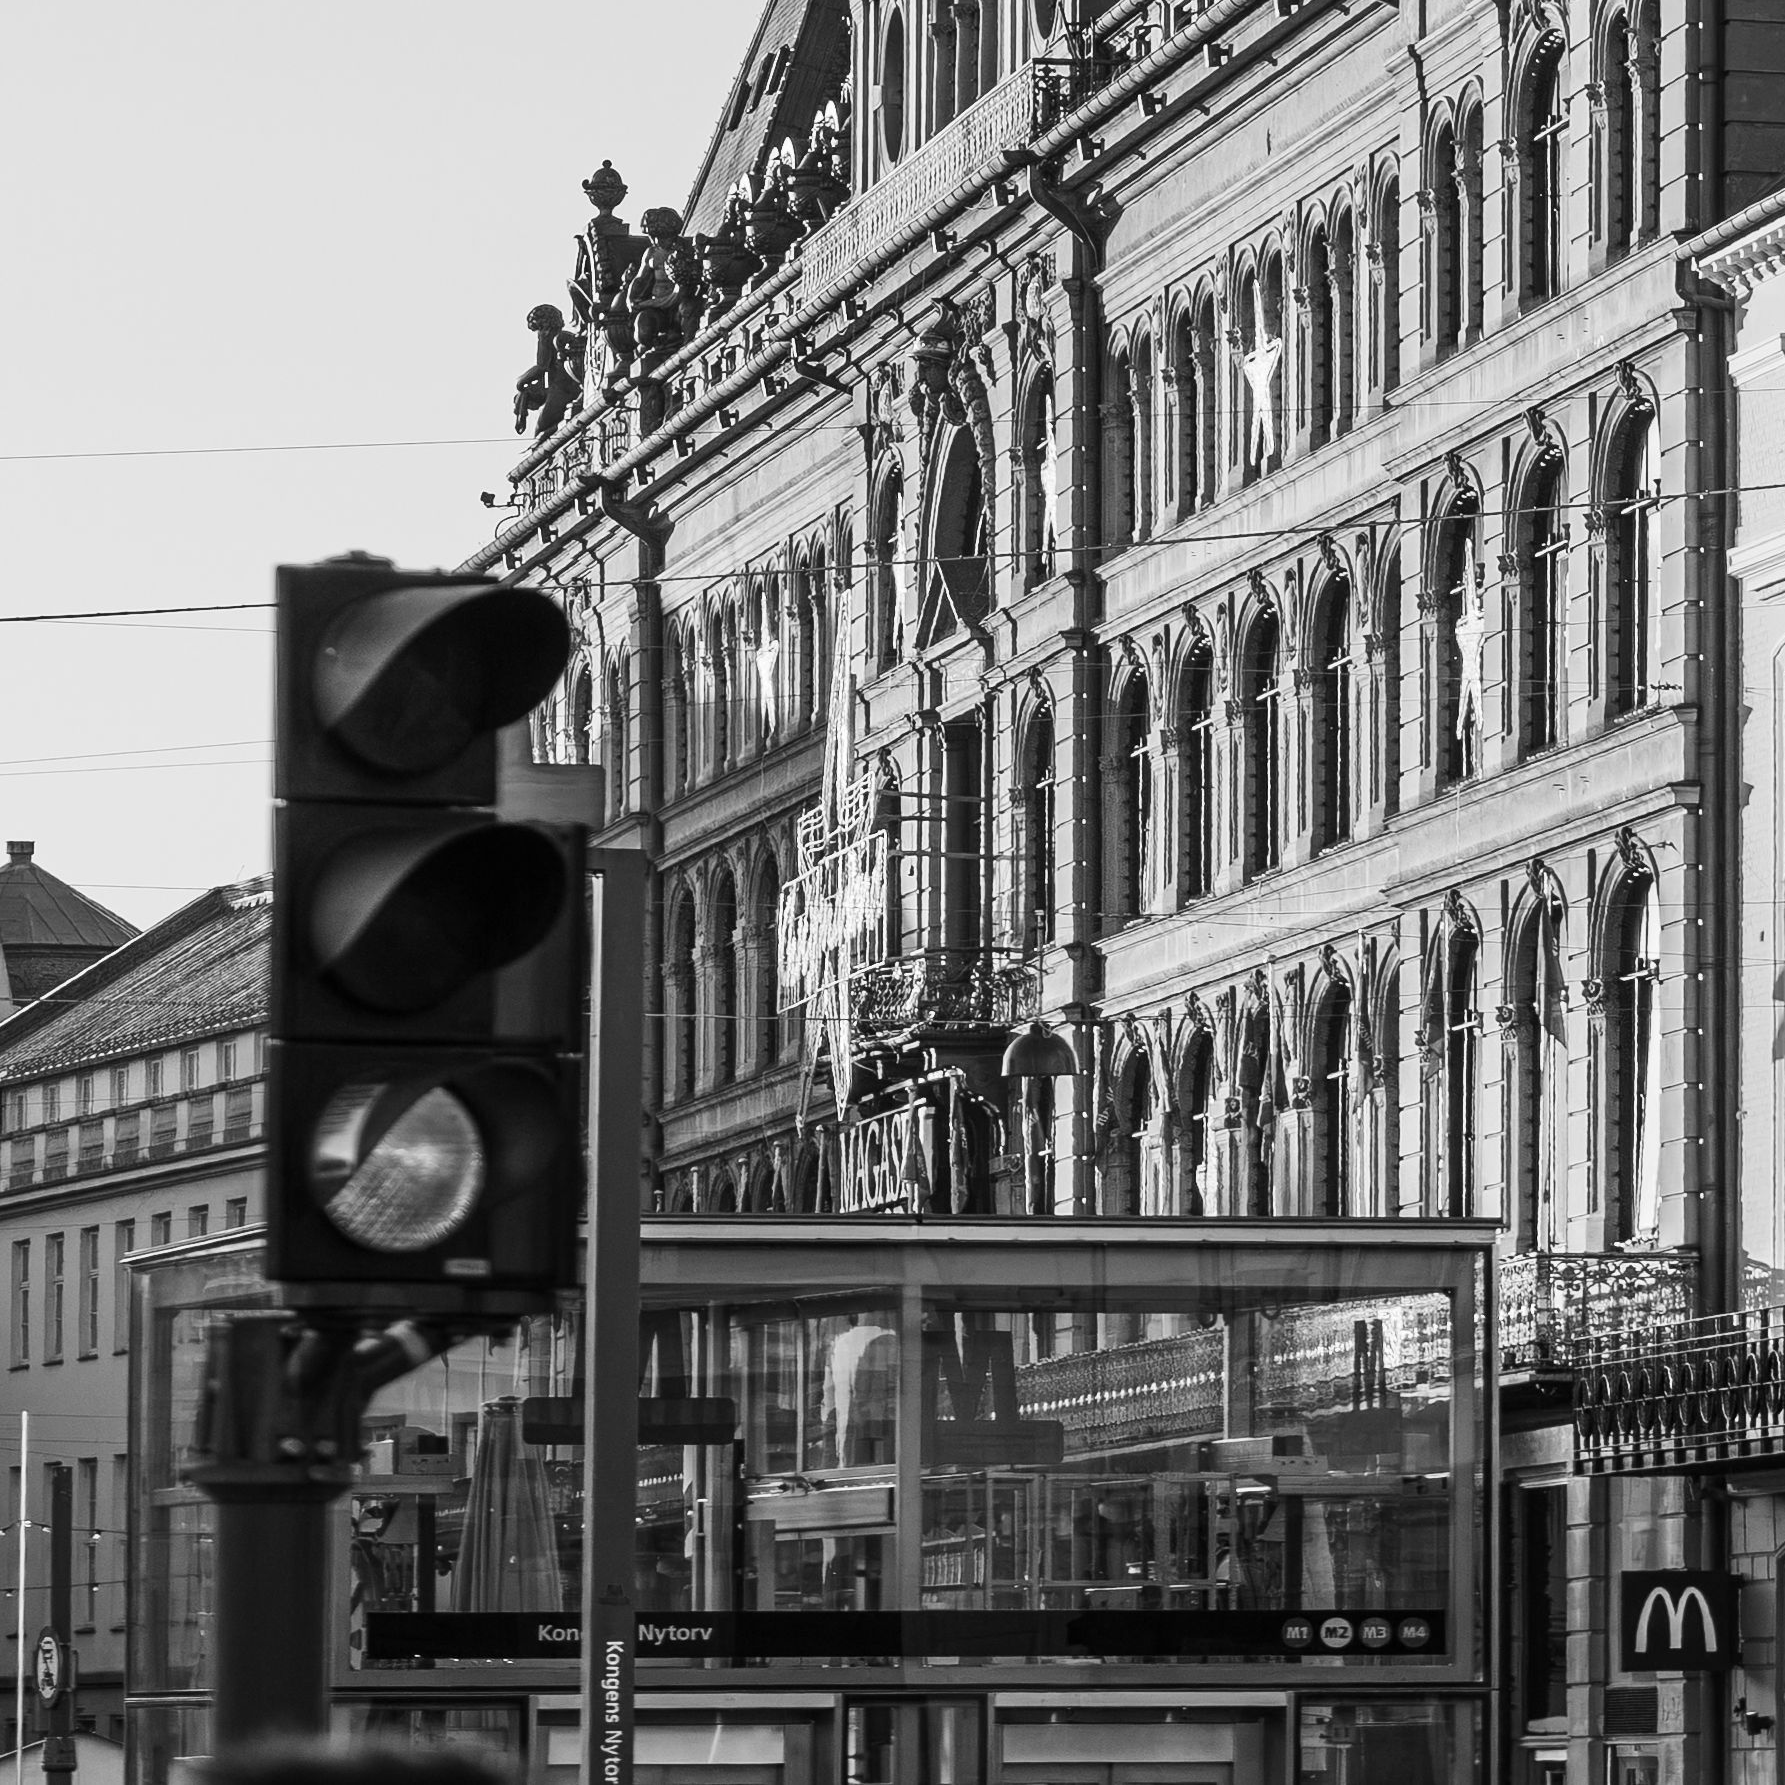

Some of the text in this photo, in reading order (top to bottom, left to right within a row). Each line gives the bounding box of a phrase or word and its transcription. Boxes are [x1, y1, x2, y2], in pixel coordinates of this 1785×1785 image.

[538, 1624, 712, 1645] Kon Nytorv
[1286, 1626, 1308, 1638] M1
[1323, 1626, 1350, 1639] M2
[1362, 1626, 1387, 1639] M3
[1402, 1626, 1426, 1638] M4
[601, 1641, 624, 1723] Kongens
